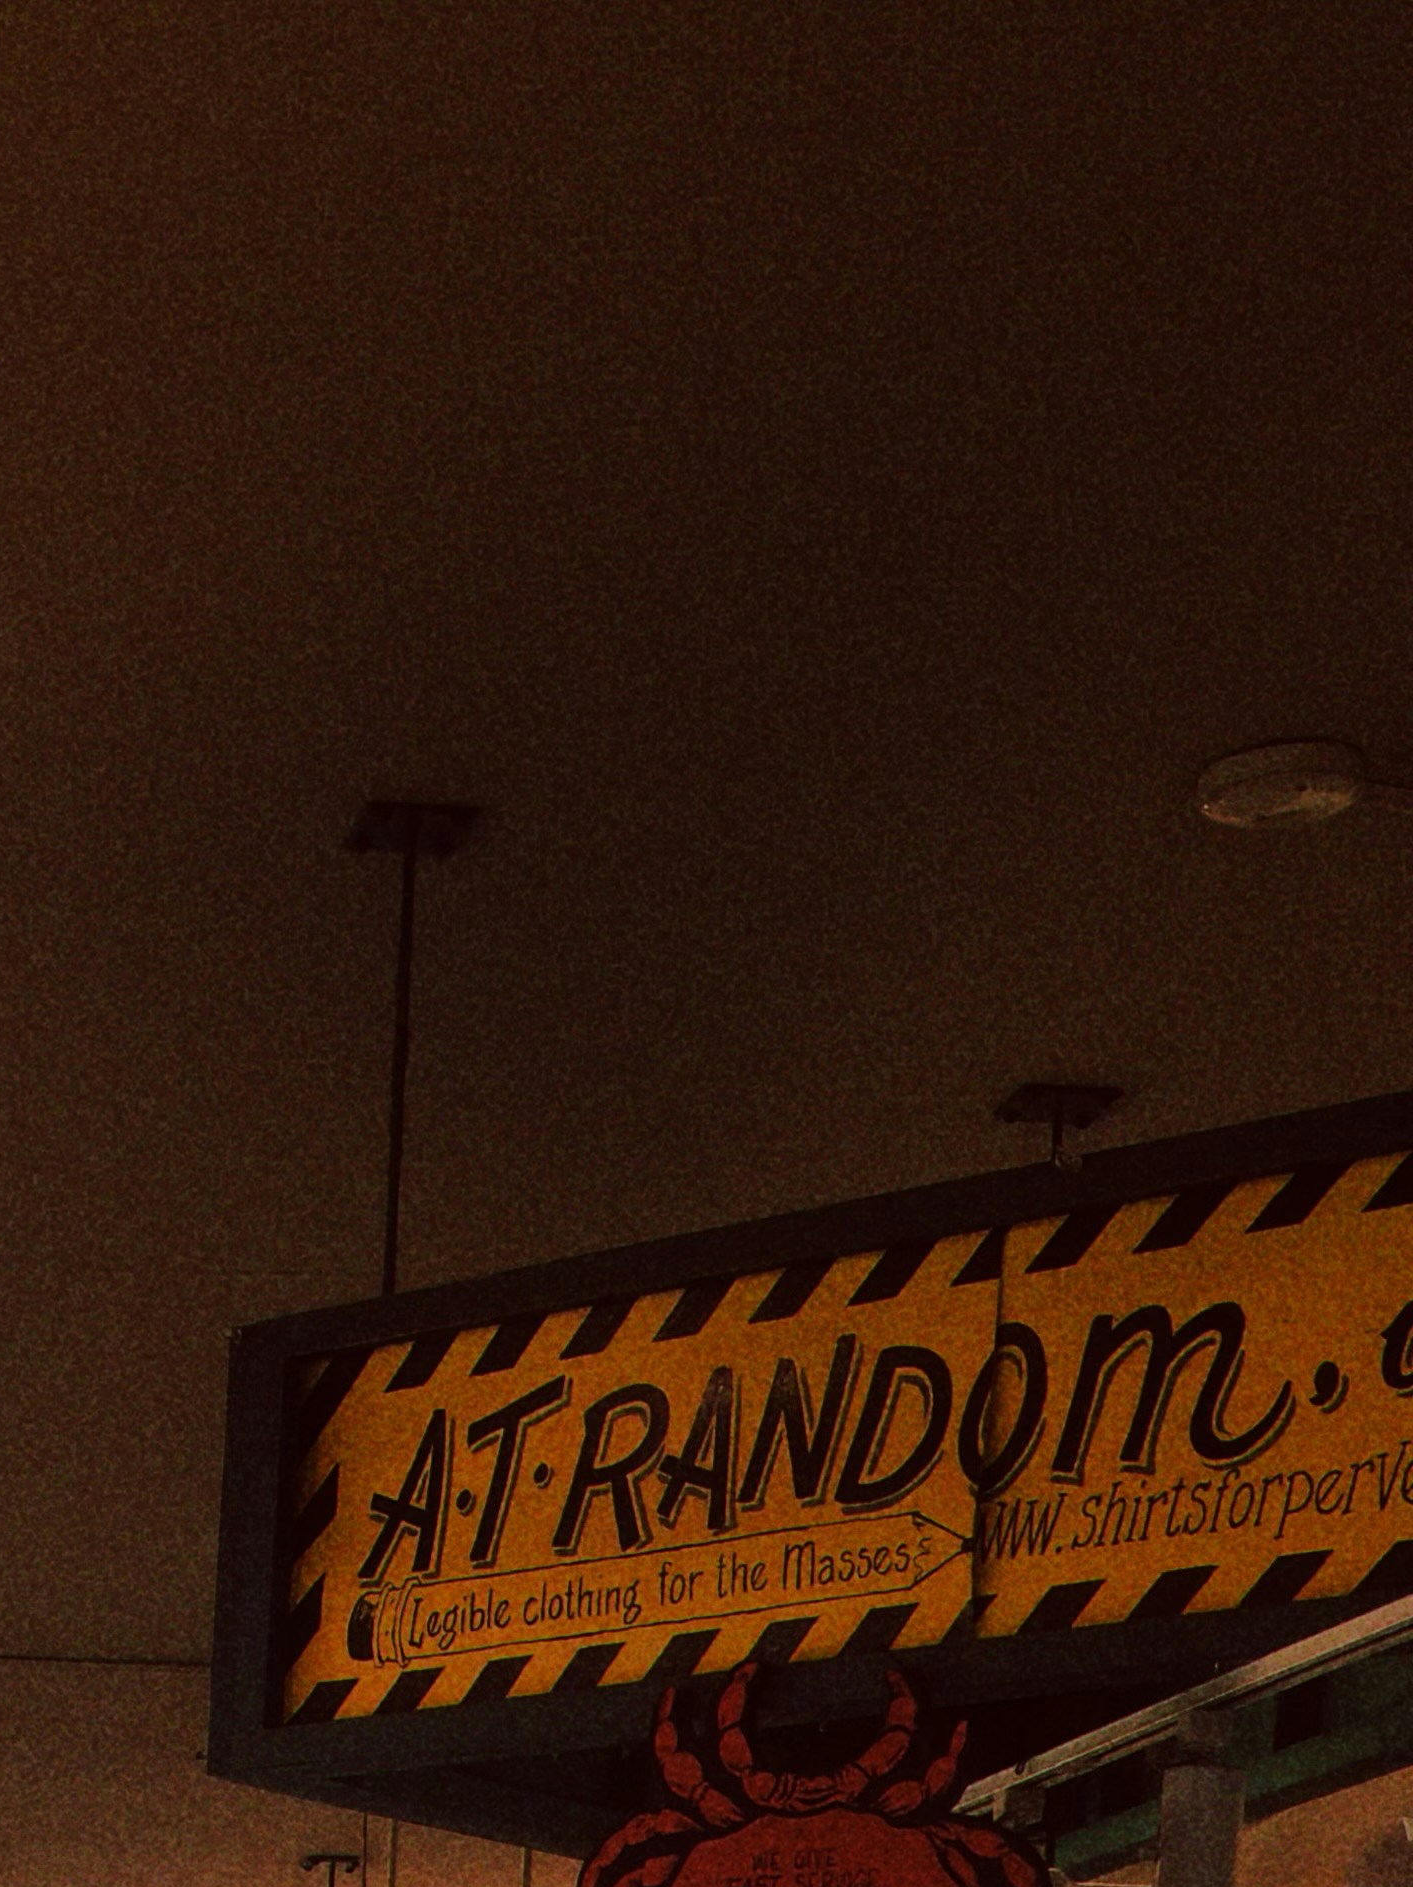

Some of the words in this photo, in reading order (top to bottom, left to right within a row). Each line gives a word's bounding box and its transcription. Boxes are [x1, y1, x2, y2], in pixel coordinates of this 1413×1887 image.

[409, 1588, 511, 1648] Legible
[523, 1582, 643, 1624] clothing
[657, 1561, 704, 1606] for
[717, 1551, 768, 1599] the
[782, 1539, 911, 1591] Masses
